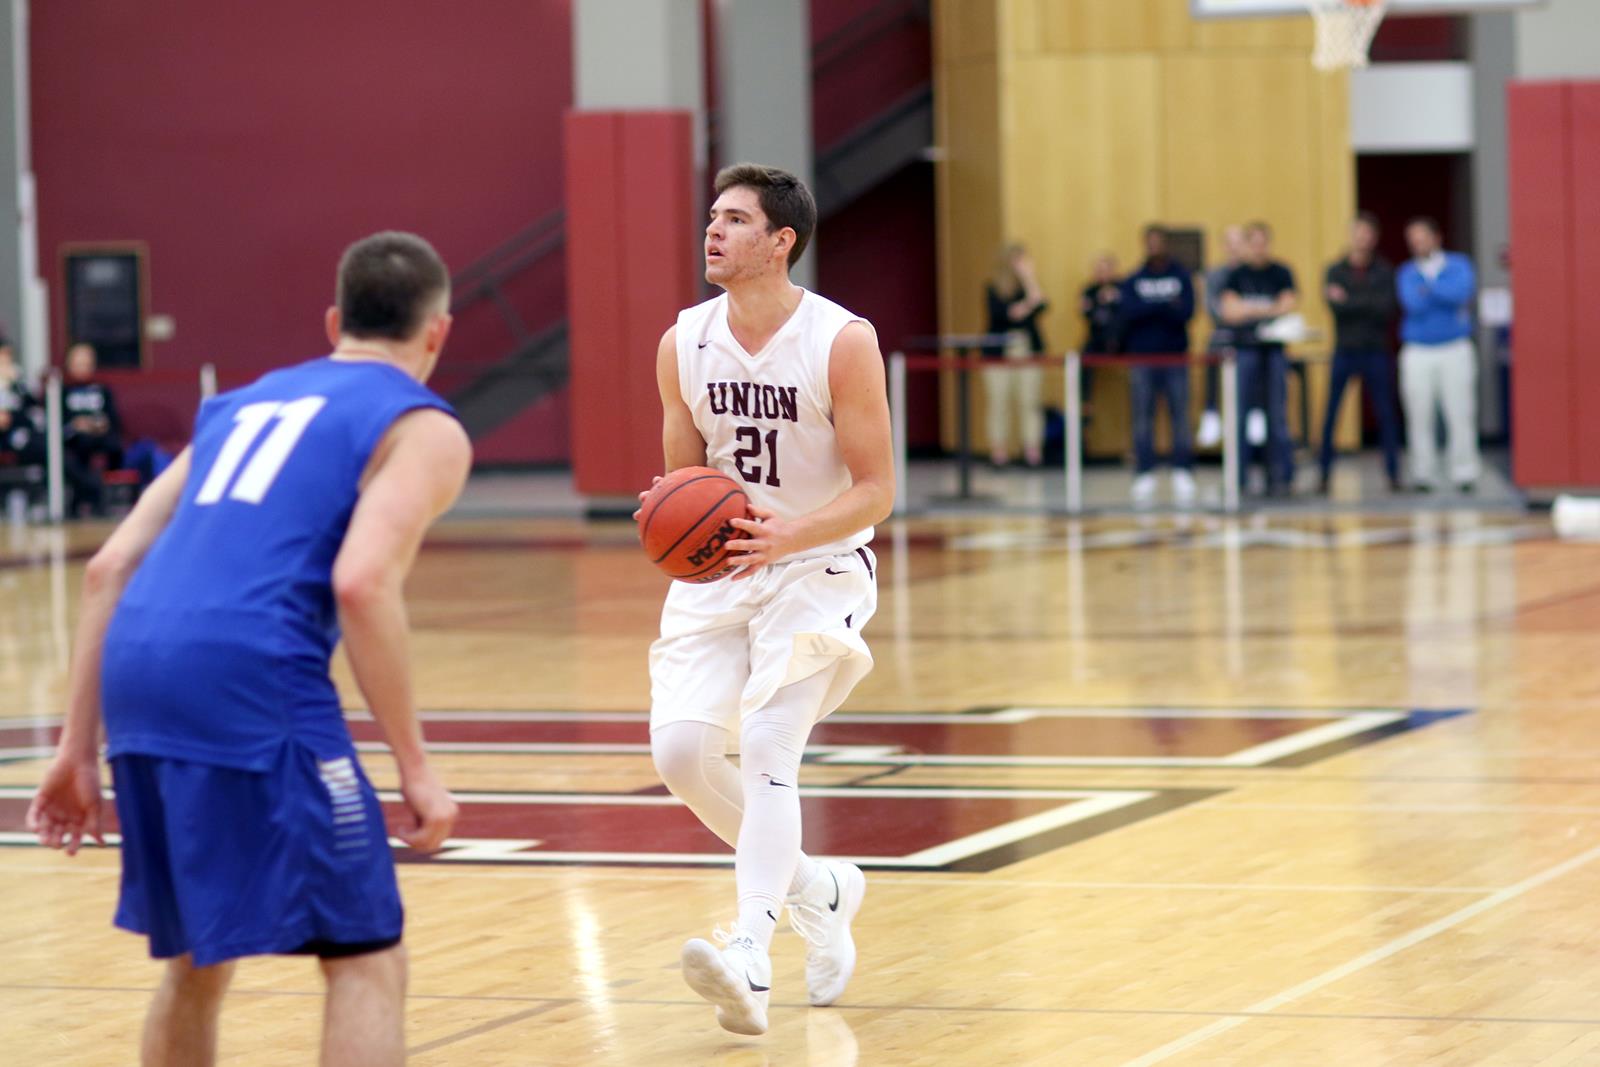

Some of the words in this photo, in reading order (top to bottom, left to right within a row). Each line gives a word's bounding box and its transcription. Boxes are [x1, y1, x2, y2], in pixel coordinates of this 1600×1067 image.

[707, 382, 798, 422] UNION
[194, 397, 327, 504] 11
[733, 426, 781, 487] 21
[687, 519, 735, 567] NCAA
